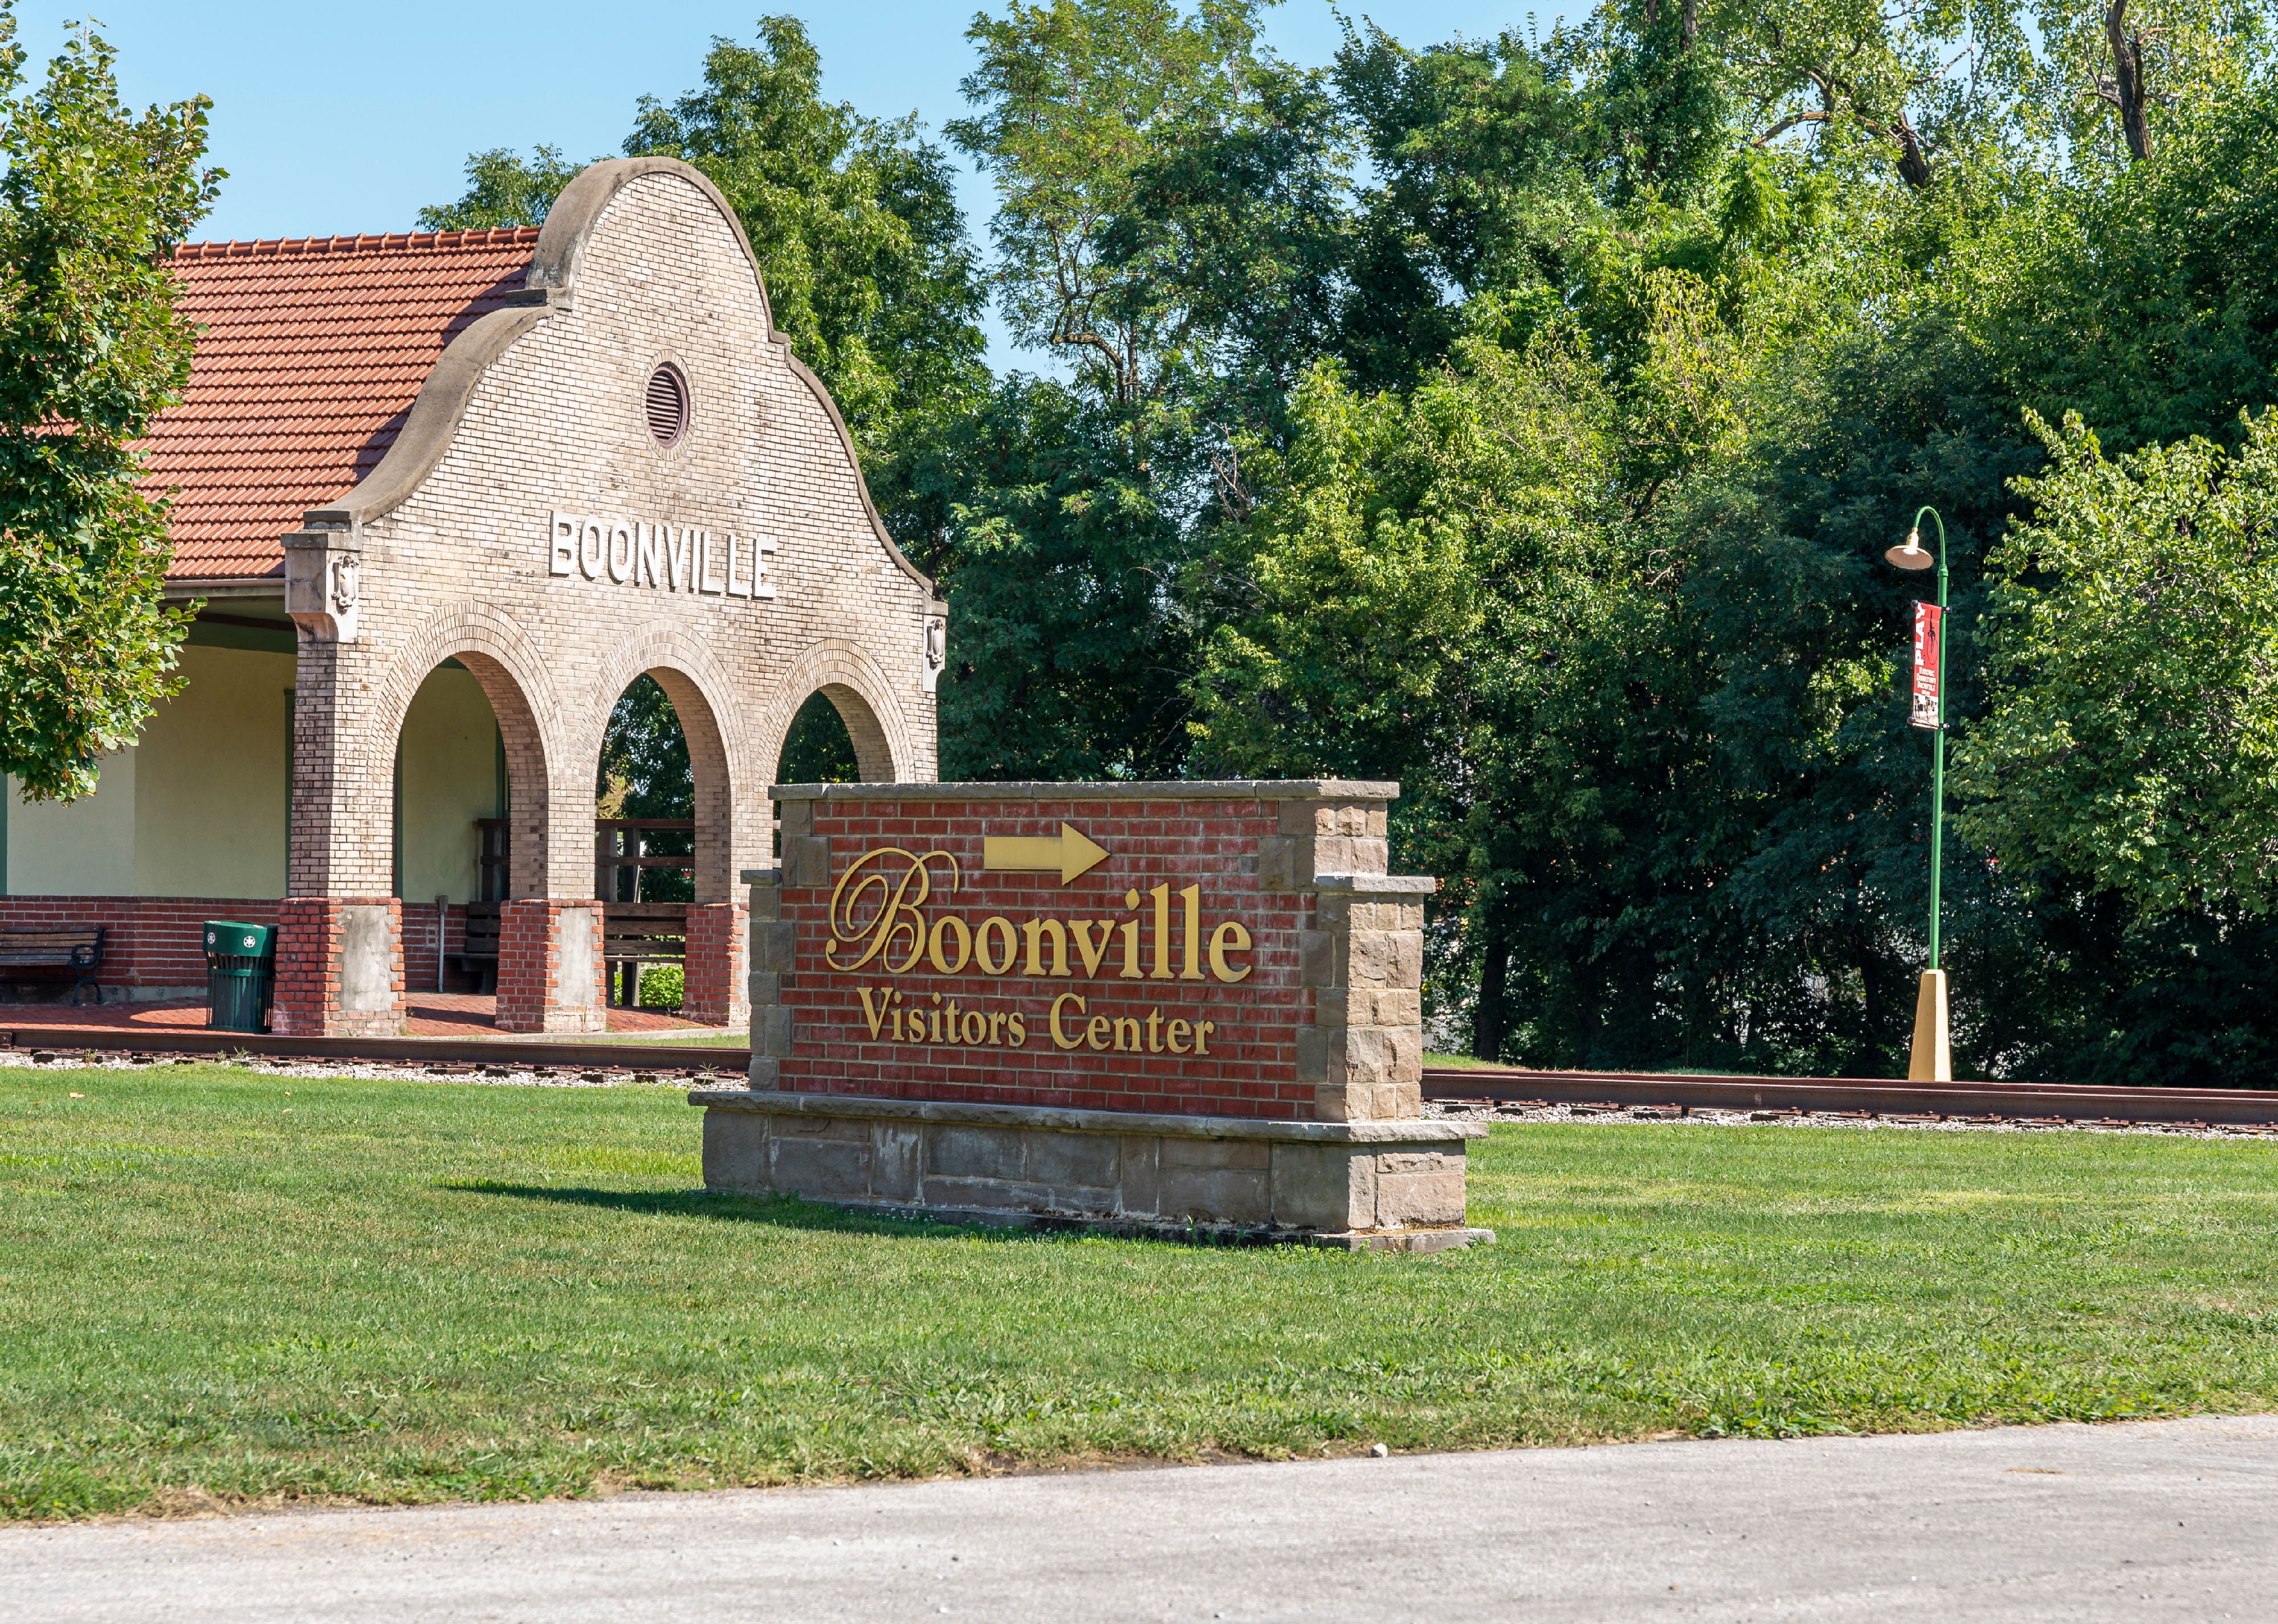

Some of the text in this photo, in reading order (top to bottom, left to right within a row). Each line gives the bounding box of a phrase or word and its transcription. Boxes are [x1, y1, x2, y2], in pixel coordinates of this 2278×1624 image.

[550, 510, 778, 599] BOONVILLE
[1915, 602, 1926, 666] PLAY
[825, 847, 1252, 983] Boonville
[856, 987, 1215, 1055] Visitors Center
